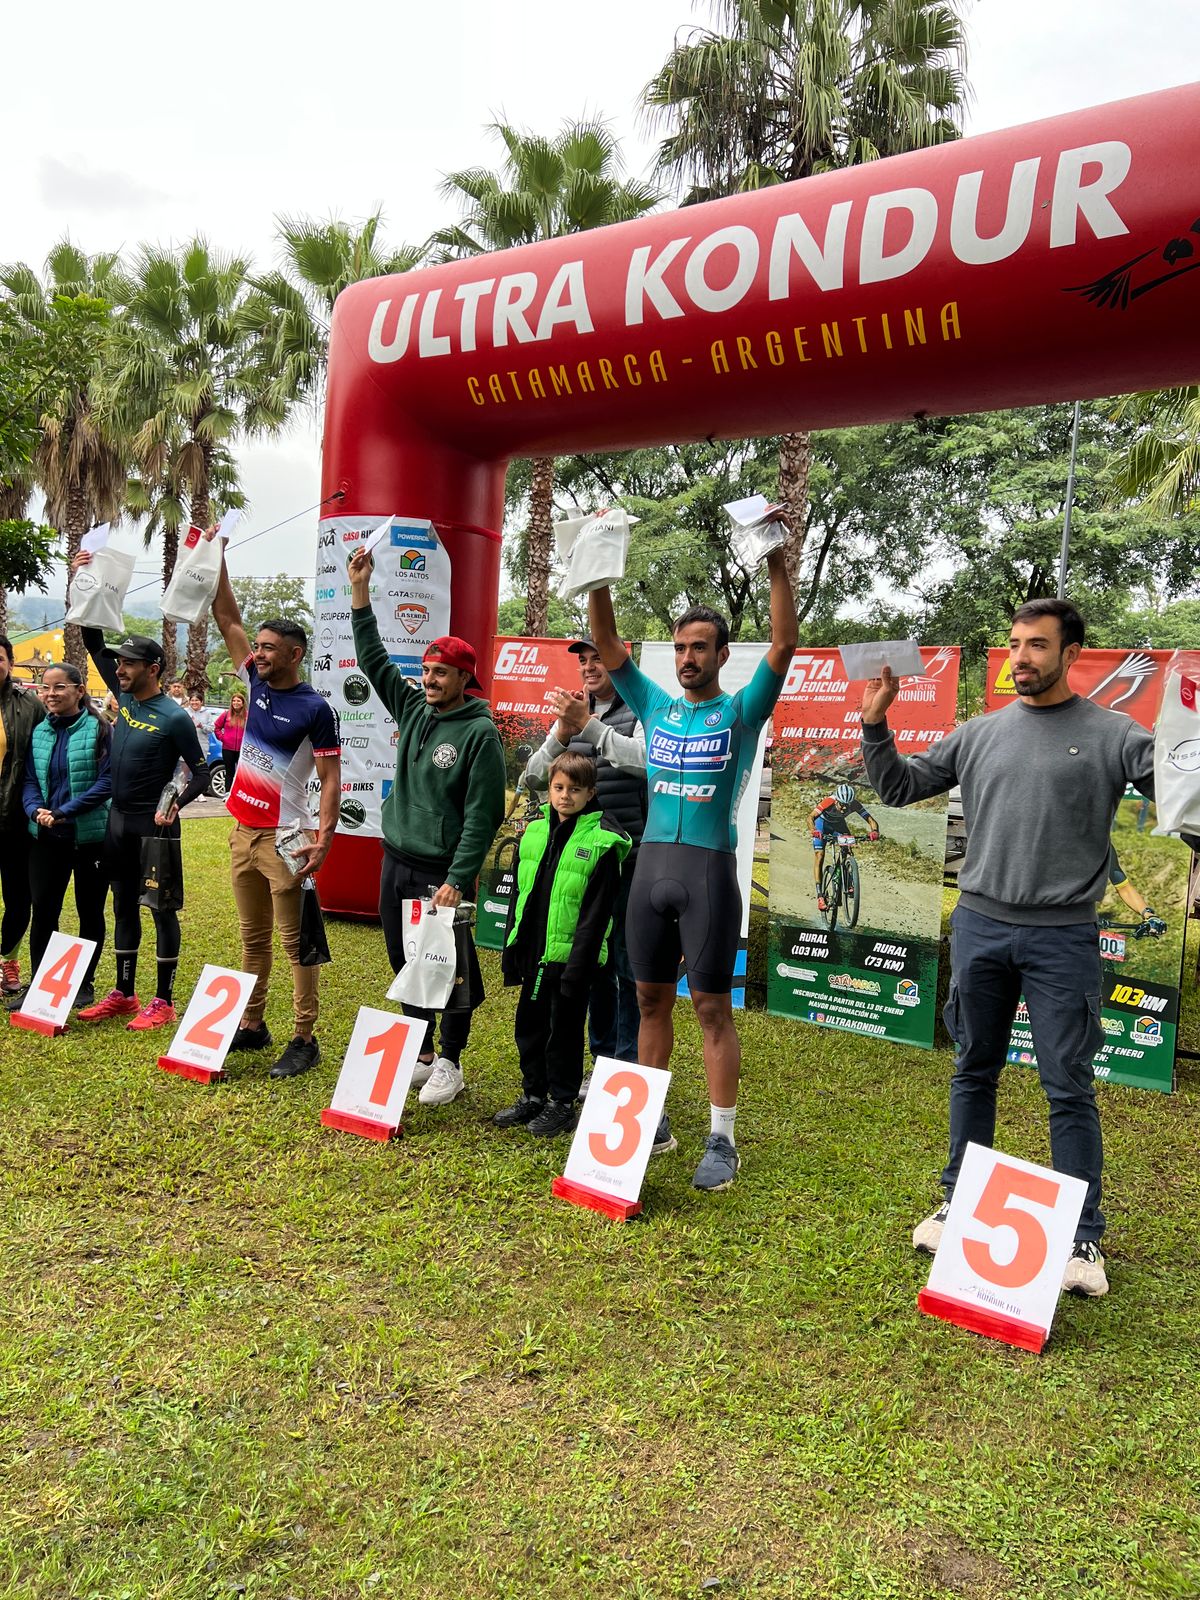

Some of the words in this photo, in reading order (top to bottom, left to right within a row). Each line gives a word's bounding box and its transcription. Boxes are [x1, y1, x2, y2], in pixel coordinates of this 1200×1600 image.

[368, 260, 594, 364] ULTRA
[625, 140, 1132, 327] KONDUR
[466, 348, 669, 406] CATAMARCA
[711, 301, 961, 374] ARGENTINA
[592, 523, 615, 532] IANI
[343, 531, 360, 542] GASO
[185, 569, 206, 584] FIANI
[409, 572, 430, 580] ALTOS
[104, 582, 120, 594] FIAN
[338, 658, 356, 669] GASO
[512, 663, 550, 676] EDICIÓN
[801, 679, 849, 694] EDICIÓN
[916, 684, 937, 692] ULTRA
[898, 690, 936, 702] KONDUR
[496, 701, 513, 712] UNA
[513, 703, 541, 714] ULTRA
[119, 706, 161, 732] SCOTT
[781, 726, 803, 738] UNA
[804, 727, 840, 739] ULTRA
[898, 729, 914, 741] DE
[916, 730, 945, 742] MTB
[651, 733, 722, 753] CASTAÑO
[650, 747, 682, 766] JEBA
[1167, 750, 1200, 763] NISS
[352, 782, 375, 792] BIKES
[653, 780, 717, 797] AERO
[236, 788, 271, 810] SRAM
[798, 932, 828, 945] RURAL
[791, 944, 810, 957] (103
[811, 946, 830, 959] KM)
[872, 942, 908, 958] RURAL
[424, 952, 448, 964] FIANI
[864, 955, 882, 968] (73
[883, 957, 905, 973] KM)
[38, 943, 83, 1008] 4
[828, 974, 882, 993] CATAMARCA
[792, 988, 828, 1001] INSCRIPCIÓN
[833, 997, 855, 1007] PARTIR
[855, 1001, 867, 1009] DEL
[867, 1002, 875, 1010] 13
[875, 1004, 884, 1012] DE
[883, 1005, 905, 1016] ENERO
[184, 975, 242, 1051] 2
[808, 1000, 829, 1010] MAYOR
[829, 1004, 870, 1018] INFORMACIÓN
[869, 1012, 880, 1021] EN:
[825, 1014, 887, 1035] ULTRAKONDUR
[1009, 1038, 1034, 1049] AYOR
[1144, 1034, 1162, 1043] ALTOS
[1101, 1044, 1115, 1054] DE
[1115, 1046, 1145, 1059] ENERO
[363, 1021, 410, 1107] 1
[588, 1071, 649, 1168] 3
[961, 1161, 1061, 1289] 5
[1005, 1302, 1022, 1316] MTB
